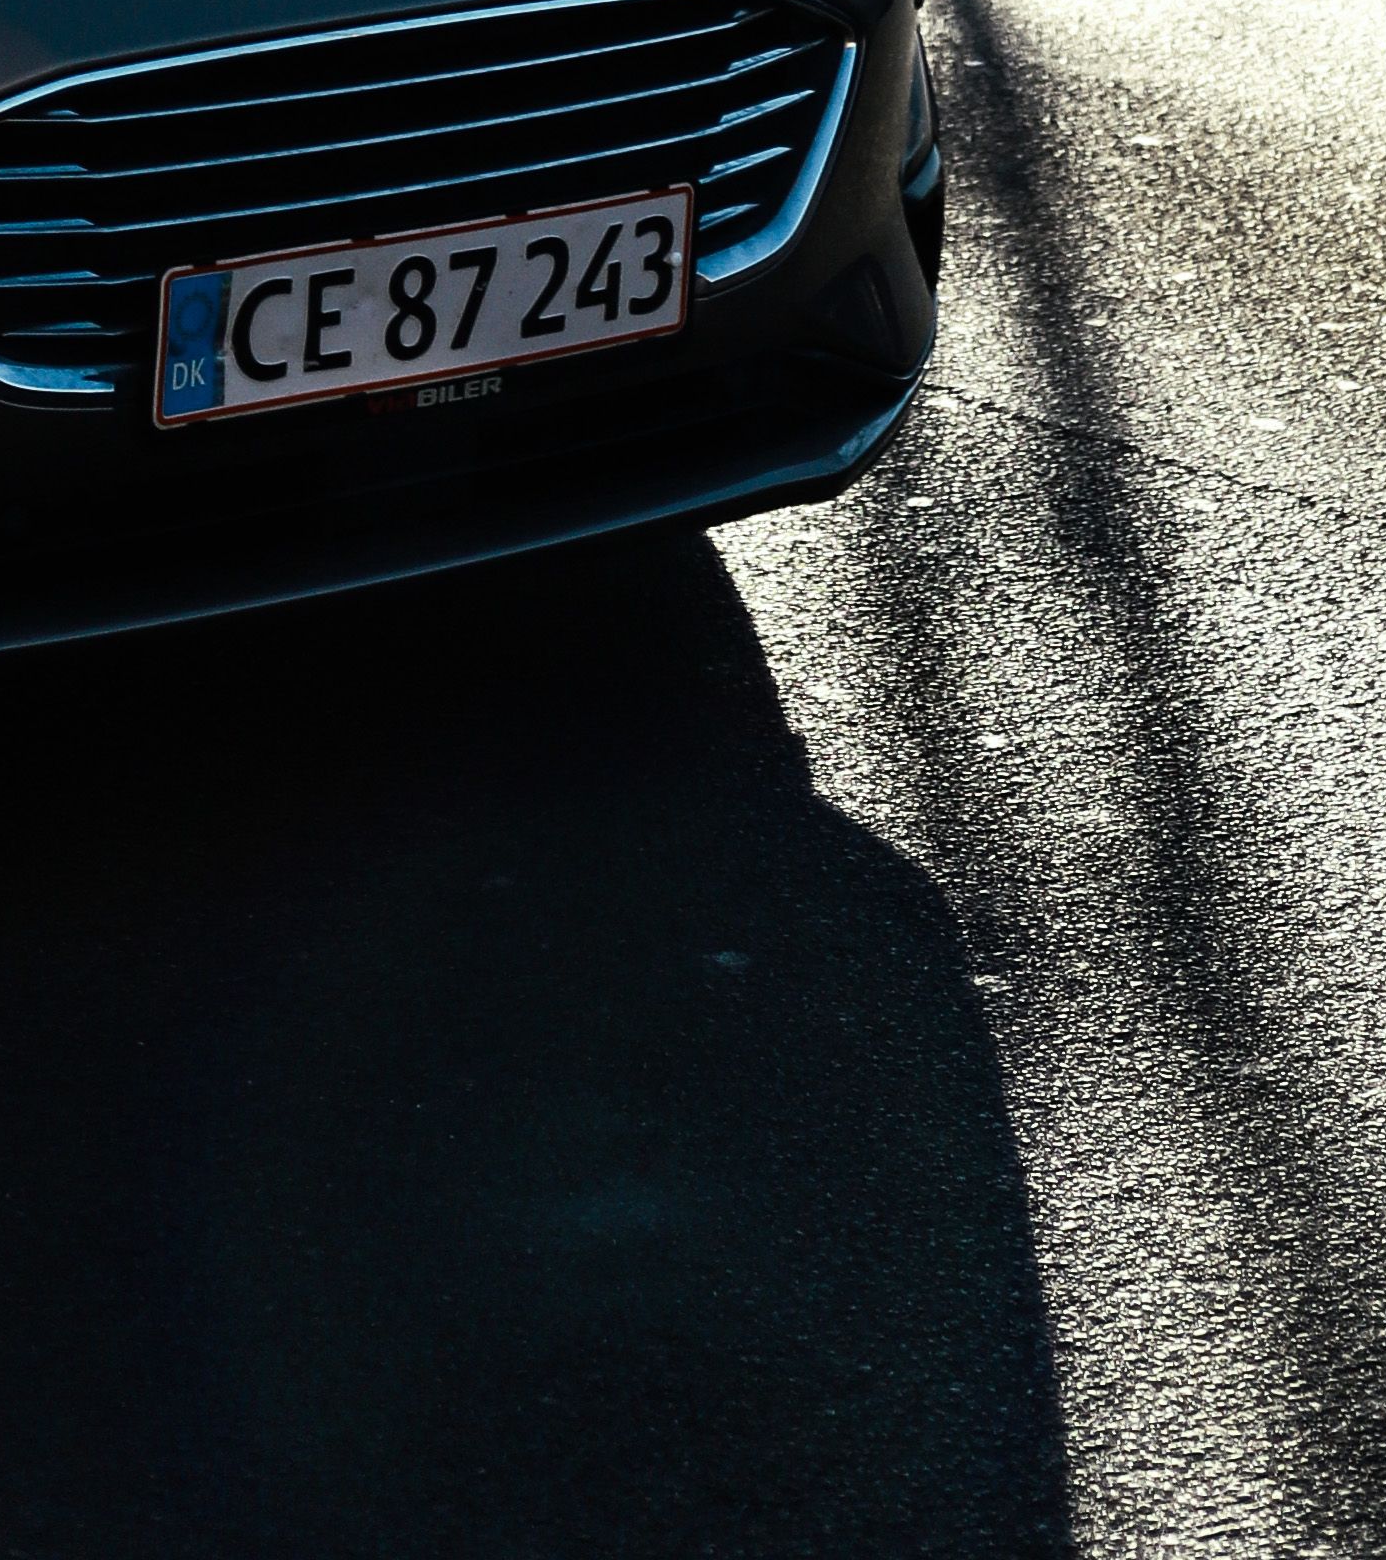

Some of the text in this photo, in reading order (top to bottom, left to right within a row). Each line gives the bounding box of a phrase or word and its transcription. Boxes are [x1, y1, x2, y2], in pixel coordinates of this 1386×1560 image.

[230, 214, 675, 384] CE 87 243
[172, 357, 206, 391] DK
